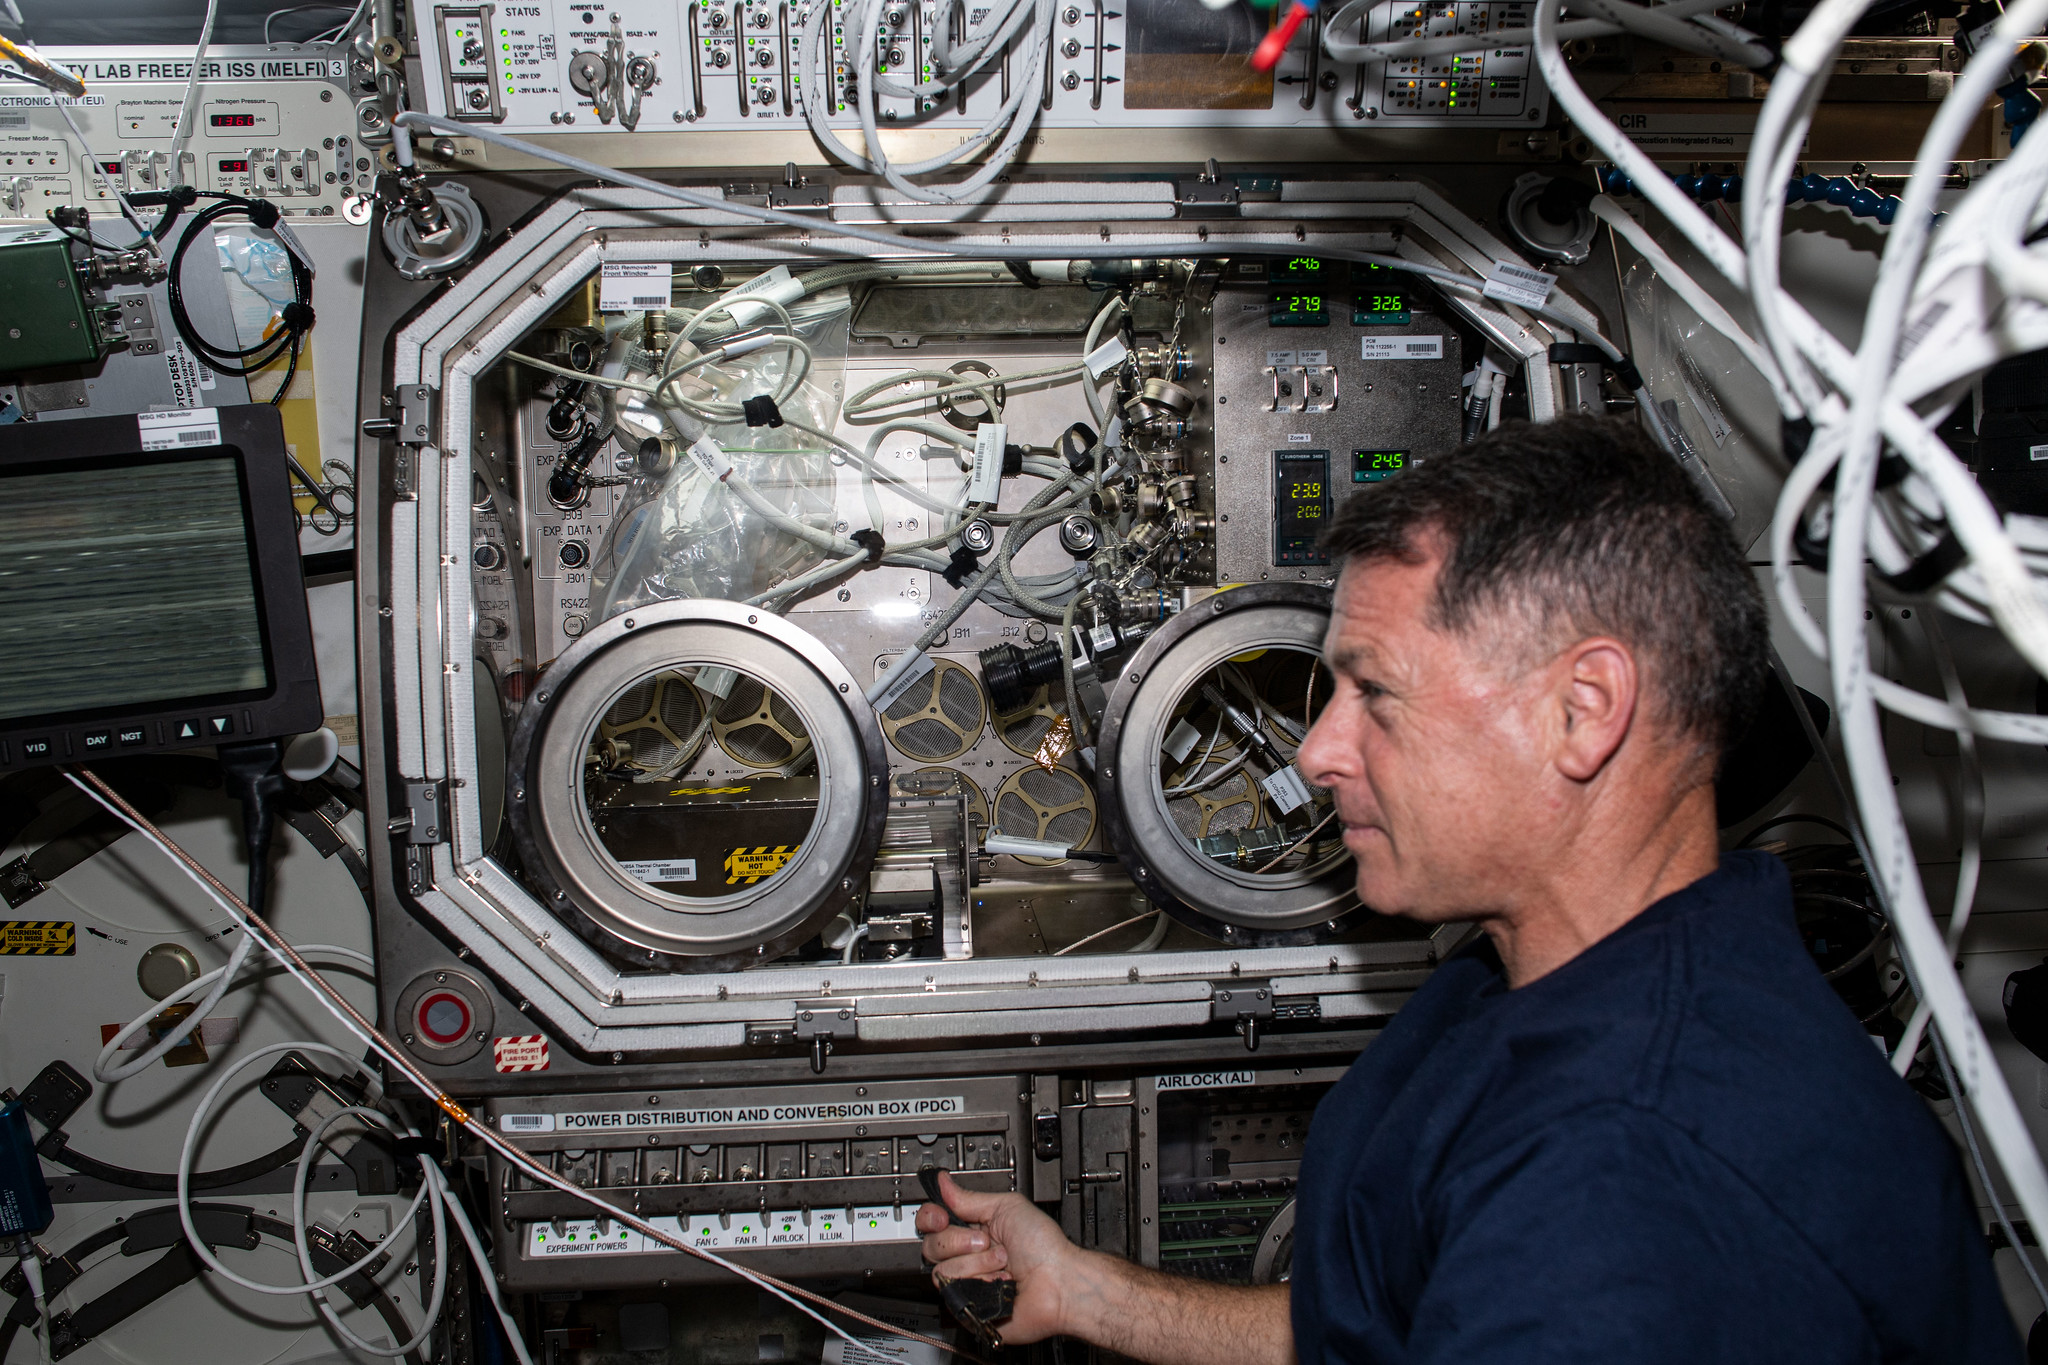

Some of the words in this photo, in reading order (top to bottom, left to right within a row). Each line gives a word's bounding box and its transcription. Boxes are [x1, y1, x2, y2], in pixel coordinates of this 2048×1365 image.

[505, 8, 541, 16] STATUS
[95, 64, 131, 79] LAB
[138, 62, 221, 79] FREEZER
[227, 62, 255, 77] ISS
[261, 60, 327, 77] (MELFI)
[332, 62, 342, 76] 3
[0, 97, 51, 106] CTRONIC
[82, 96, 105, 105] (EU)
[216, 98, 240, 106] Nitrogen
[1619, 114, 1647, 129] CIR
[1628, 136, 1669, 144] ombustion
[1670, 136, 1710, 146] Integrated
[1711, 136, 1734, 146] Rack)
[1289, 296, 1321, 311] 27.9
[1372, 296, 1402, 311] 32.6
[167, 354, 182, 381] DESK
[1372, 453, 1403, 468] 24.5
[1291, 483, 1321, 499] 23.9
[1297, 505, 1321, 518] 20.0
[543, 526, 563, 536] EXP.
[568, 525, 593, 535] DATA
[597, 525, 602, 534] 1
[561, 598, 589, 608] RS422
[921, 610, 947, 621] RS42
[86, 735, 108, 746] DAY
[120, 731, 143, 742] NGT
[26, 742, 47, 754] VID
[1279, 795, 1293, 810] Camera
[1157, 1074, 1223, 1089] AIRLOCK
[1225, 1071, 1254, 1085] (AL)
[565, 1114, 621, 1127] POWER
[626, 1110, 733, 1126] DISTRIBUTION
[737, 1108, 770, 1121] AND
[773, 1104, 874, 1120] CONVERSION
[879, 1101, 910, 1115] BOX
[915, 1099, 957, 1113] (PDC)
[781, 1215, 797, 1223] +28V
[734, 1236, 749, 1244] FAN
[752, 1235, 757, 1243] R
[772, 1233, 804, 1243] AIRLOCK
[819, 1232, 845, 1240] ILLUM.
[546, 1243, 594, 1253] EXPERIMENT
[597, 1241, 628, 1251] POWERS
[695, 1238, 711, 1247] FAN
[712, 1238, 718, 1246] C
